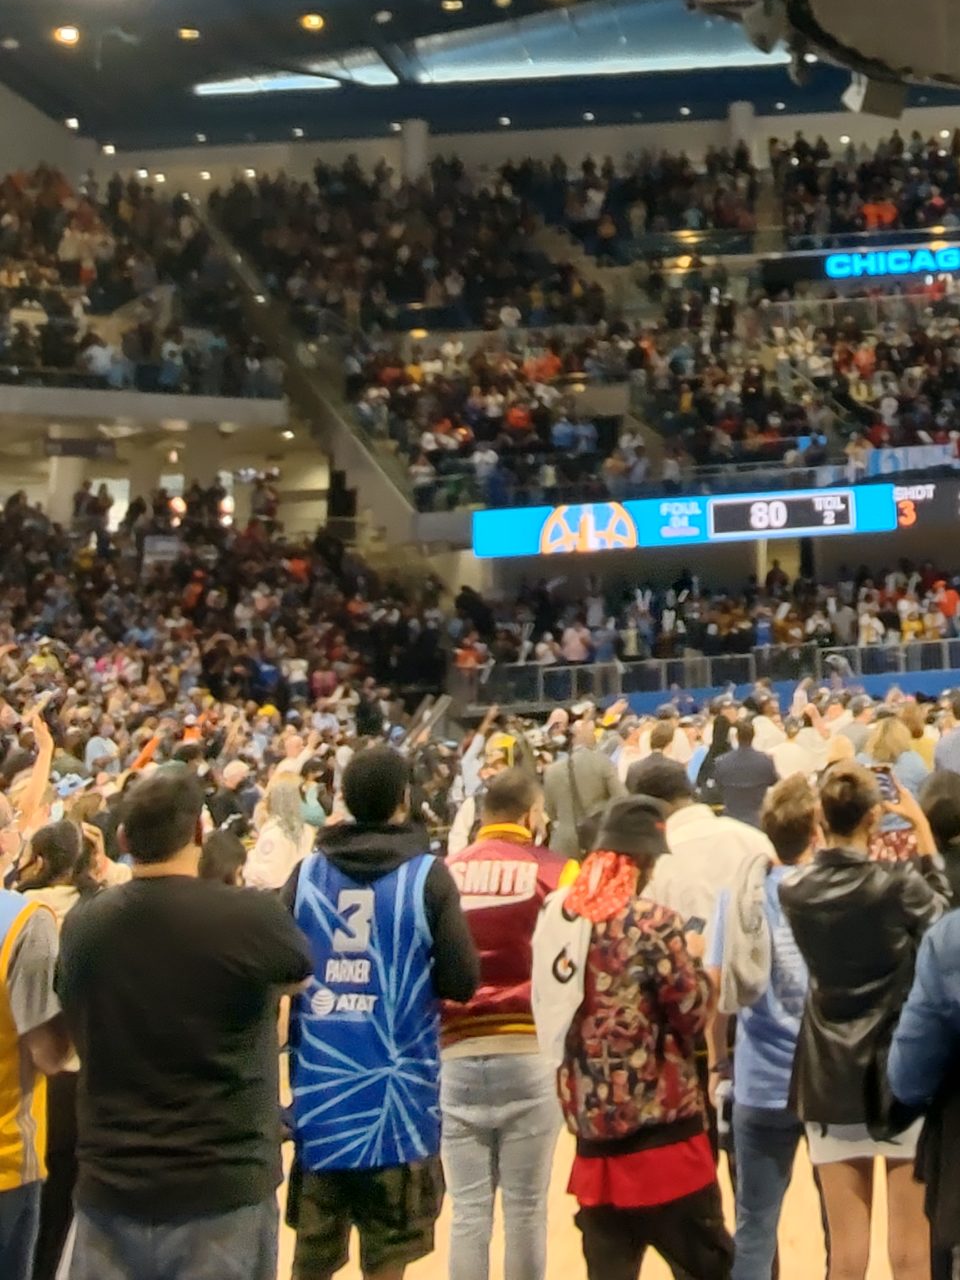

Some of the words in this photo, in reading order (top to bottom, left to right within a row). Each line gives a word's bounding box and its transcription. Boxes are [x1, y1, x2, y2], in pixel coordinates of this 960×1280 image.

[750, 500, 788, 530] 80
[823, 510, 836, 525] 2
[897, 499, 917, 527] 3
[450, 859, 539, 896] SMITH
[332, 887, 376, 953] 3
[325, 958, 371, 984] PARKER
